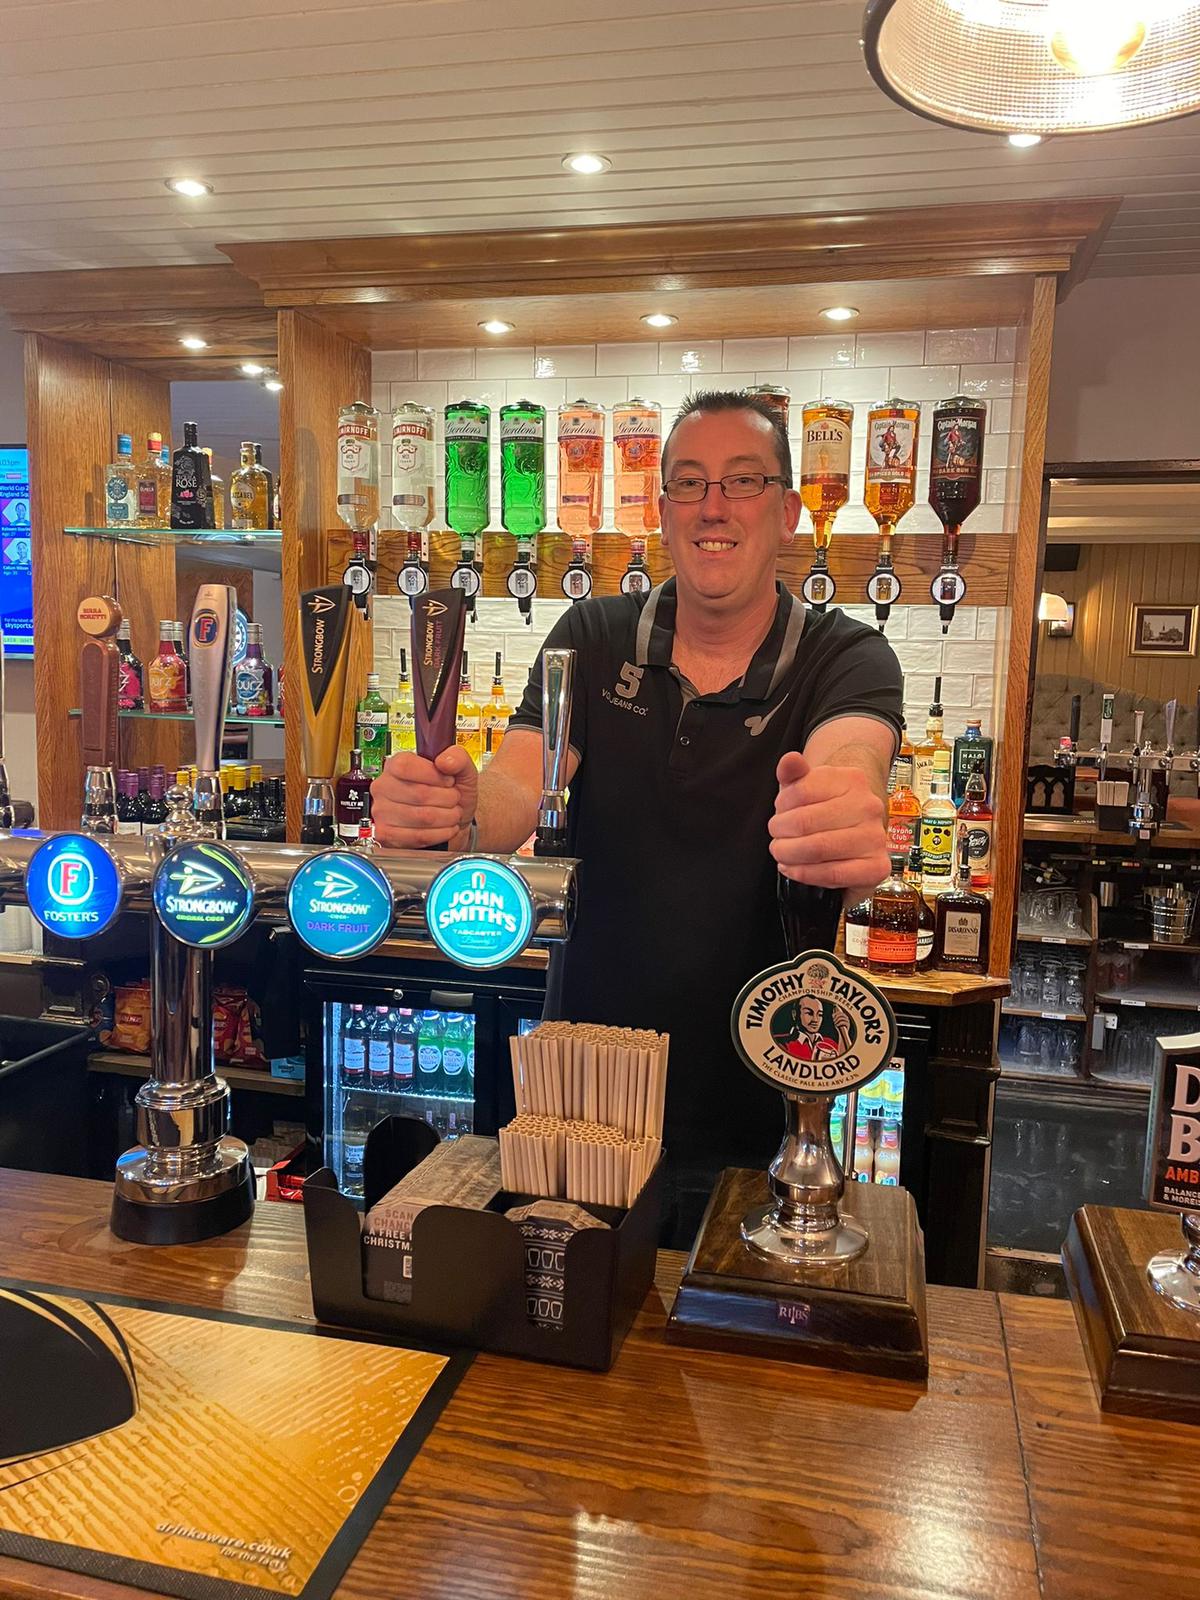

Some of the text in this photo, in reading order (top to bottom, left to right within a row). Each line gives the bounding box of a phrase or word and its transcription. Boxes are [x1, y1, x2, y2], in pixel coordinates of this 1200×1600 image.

[806, 428, 843, 443] BELL'S
[200, 618, 213, 641] F
[311, 618, 326, 674] STRONGBOW
[423, 620, 434, 666] STRONGBOW
[58, 862, 83, 898] F
[165, 894, 236, 914] STRONGBOW
[308, 898, 369, 915] STRONGBOW
[448, 889, 504, 910] JOHN
[43, 910, 99, 923] FOSTER'S
[439, 905, 517, 933] SMITH'S
[306, 920, 370, 933] DARK FRUIT
[778, 988, 833, 1002] CHAMPIONSHIP
[745, 972, 884, 1045] TIMOTHY TAYLOR'S
[762, 1045, 861, 1080] LANDLORD
[385, 1208, 413, 1220] SCAN
[374, 1217, 411, 1231] CHANC
[369, 1227, 406, 1241] A FREE
[363, 1235, 413, 1251] CHRISTM
[219, 1546, 236, 1558] for
[238, 1549, 257, 1561] the
